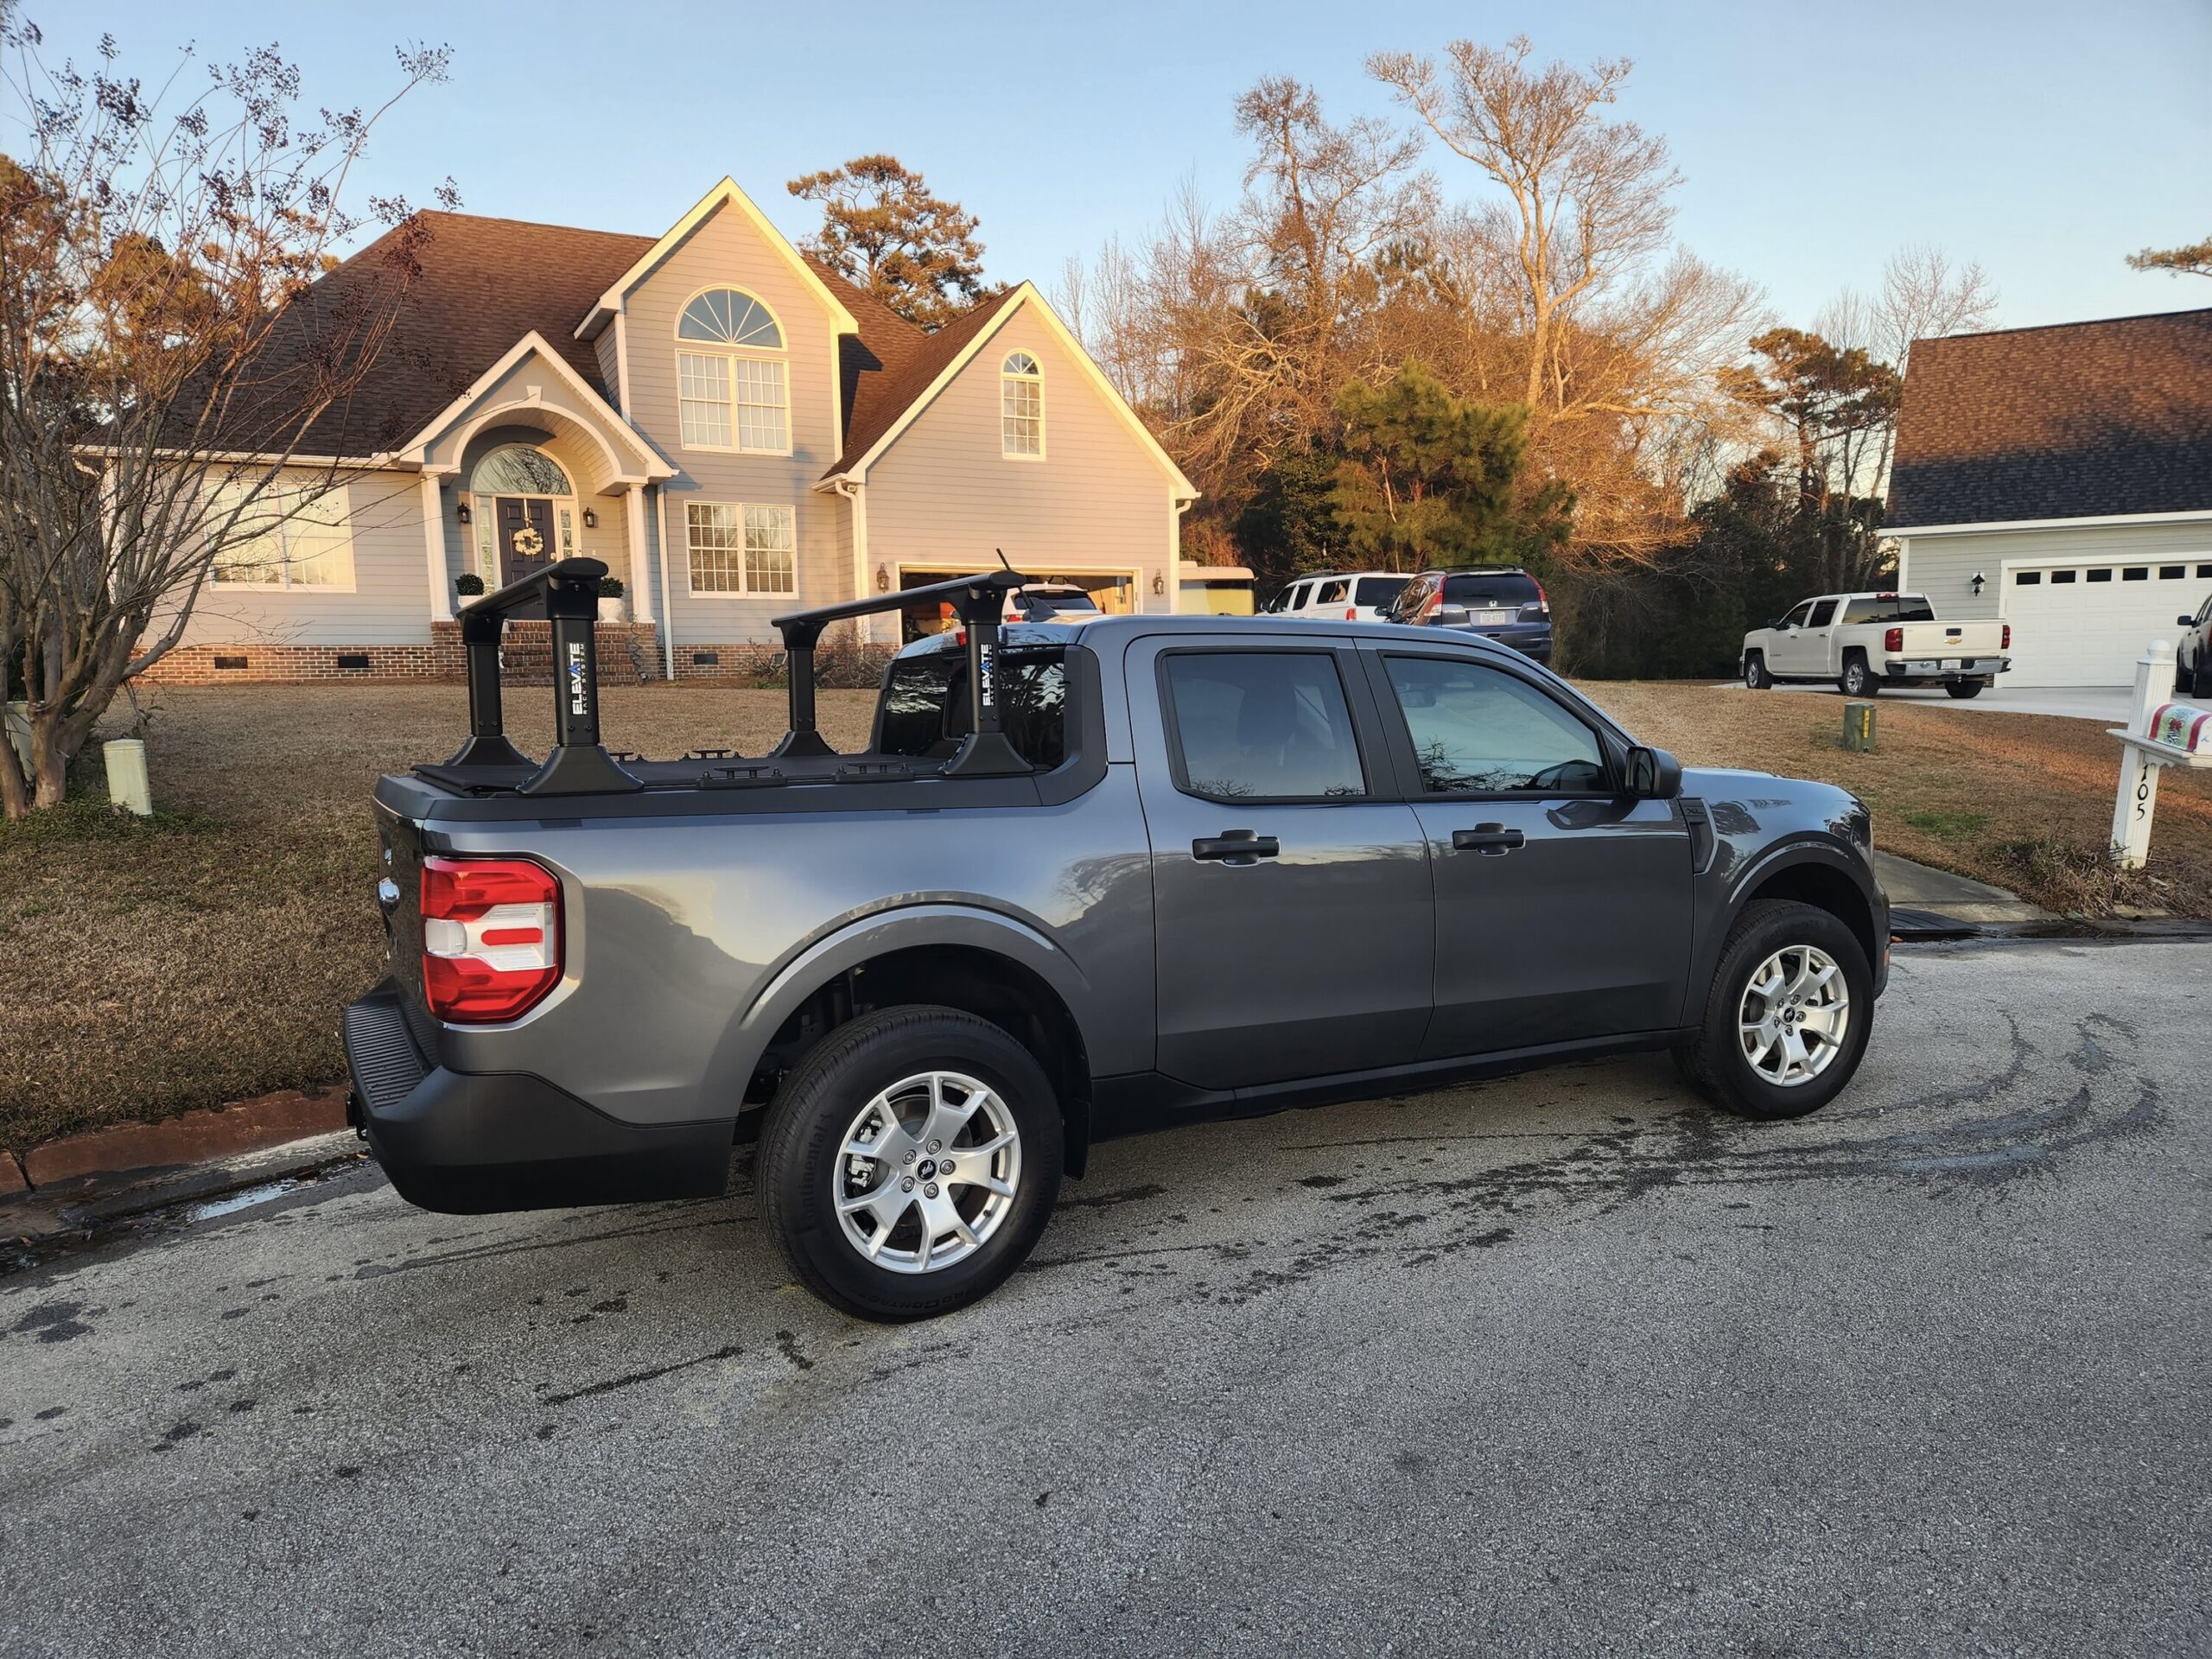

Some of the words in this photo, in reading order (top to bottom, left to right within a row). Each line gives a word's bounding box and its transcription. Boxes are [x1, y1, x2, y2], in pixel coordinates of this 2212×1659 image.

[568, 643, 583, 715] ELEVATE
[980, 644, 991, 706] ELEVATE
[2136, 764, 2149, 821] 105
